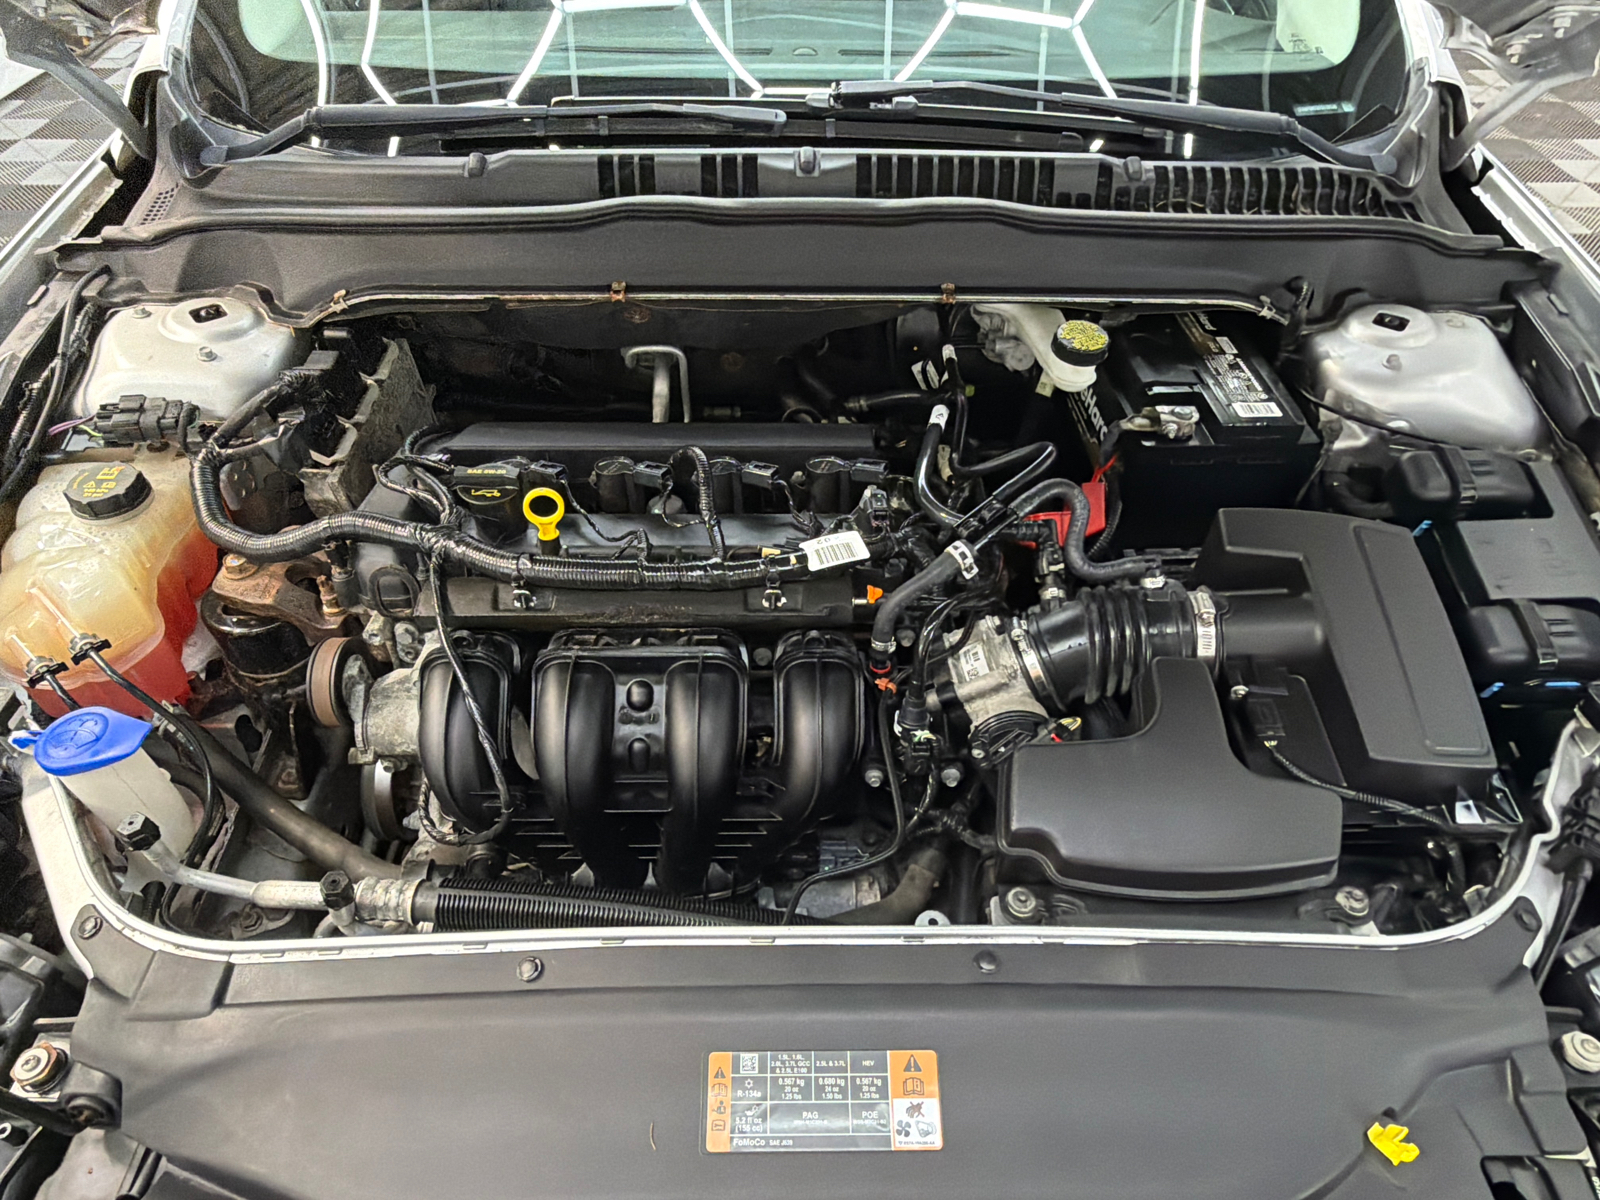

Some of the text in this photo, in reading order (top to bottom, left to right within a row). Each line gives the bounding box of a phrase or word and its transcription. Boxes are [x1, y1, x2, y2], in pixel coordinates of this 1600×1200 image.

[796, 1078, 804, 1086] kg
[837, 1078, 845, 1086] kg
[874, 1078, 881, 1086] kg
[733, 1138, 765, 1146] FoMoCo
